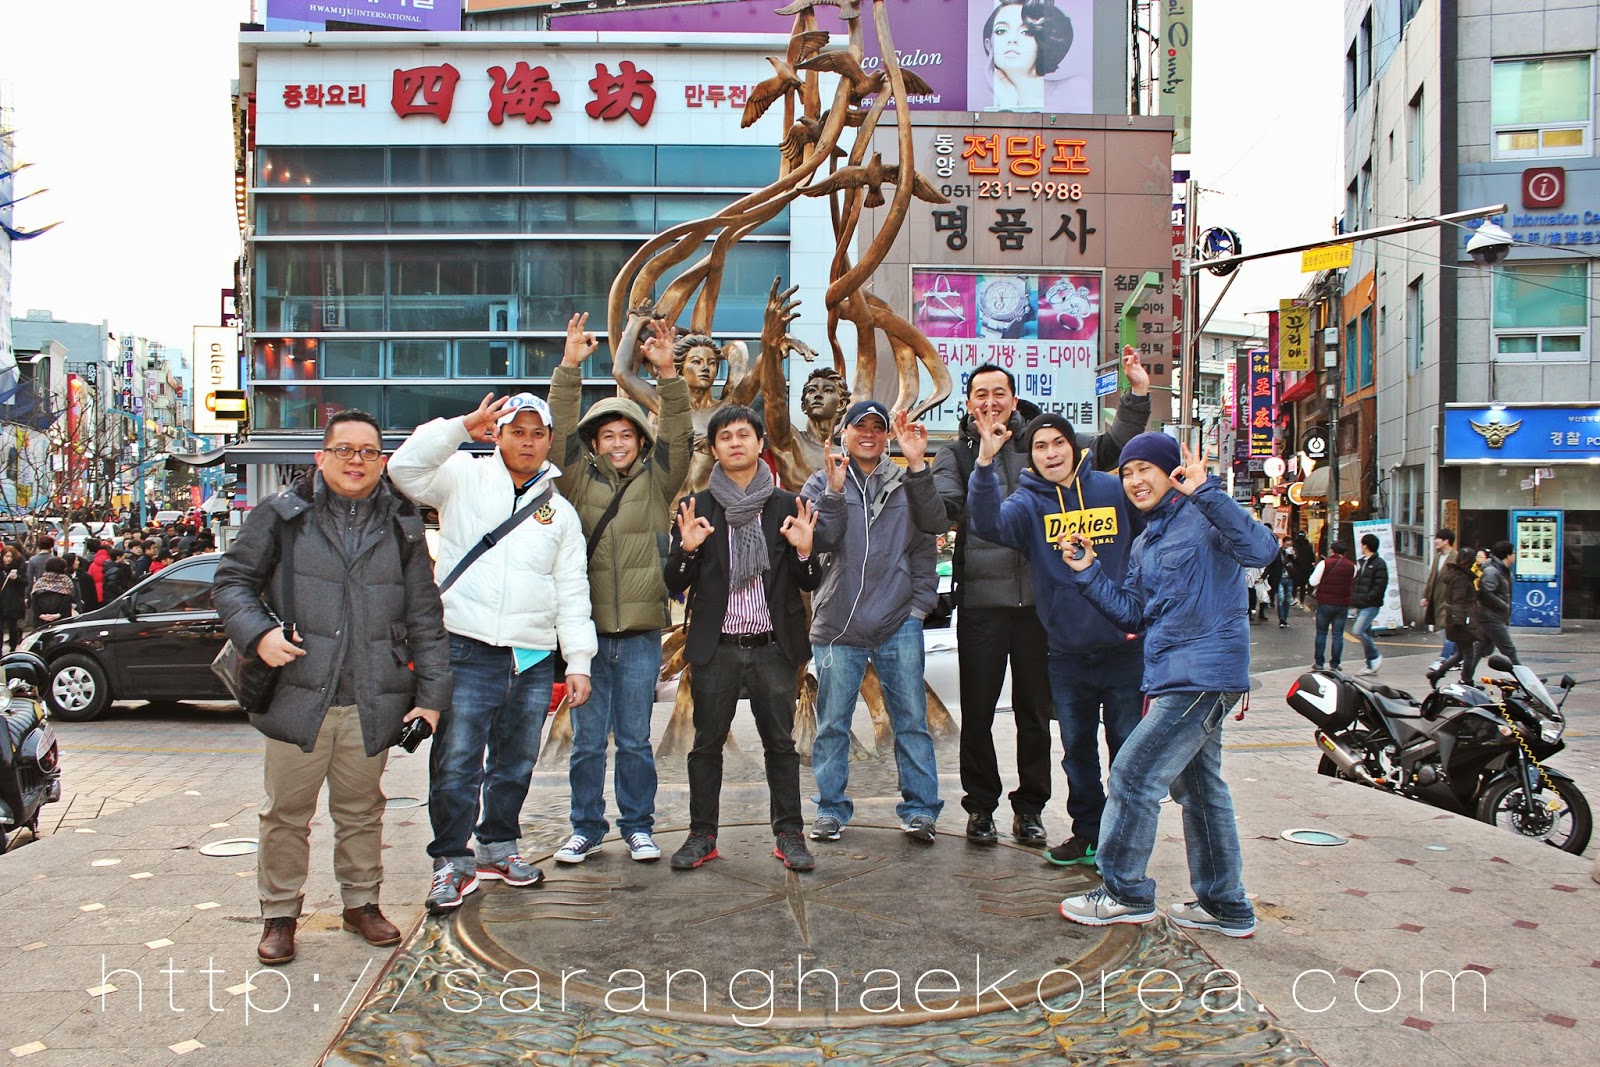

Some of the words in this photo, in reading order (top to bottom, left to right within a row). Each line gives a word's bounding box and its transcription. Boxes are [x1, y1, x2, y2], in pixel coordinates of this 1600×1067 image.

[1162, 21, 1189, 95] County
[282, 84, 366, 108] 중화요리
[391, 60, 657, 127] 四海坊
[684, 84, 757, 109] 만두전
[934, 134, 956, 178] 동양
[961, 133, 1091, 176] 전당포
[941, 184, 971, 198] 051
[978, 180, 1083, 201] 231-9988
[1512, 213, 1579, 228] Information
[1025, 346, 1038, 368] 금
[1050, 346, 1091, 369] 다이아
[1025, 372, 1053, 397] 매입
[1550, 431, 1581, 446] 경찰
[1048, 513, 1114, 538] Dickies
